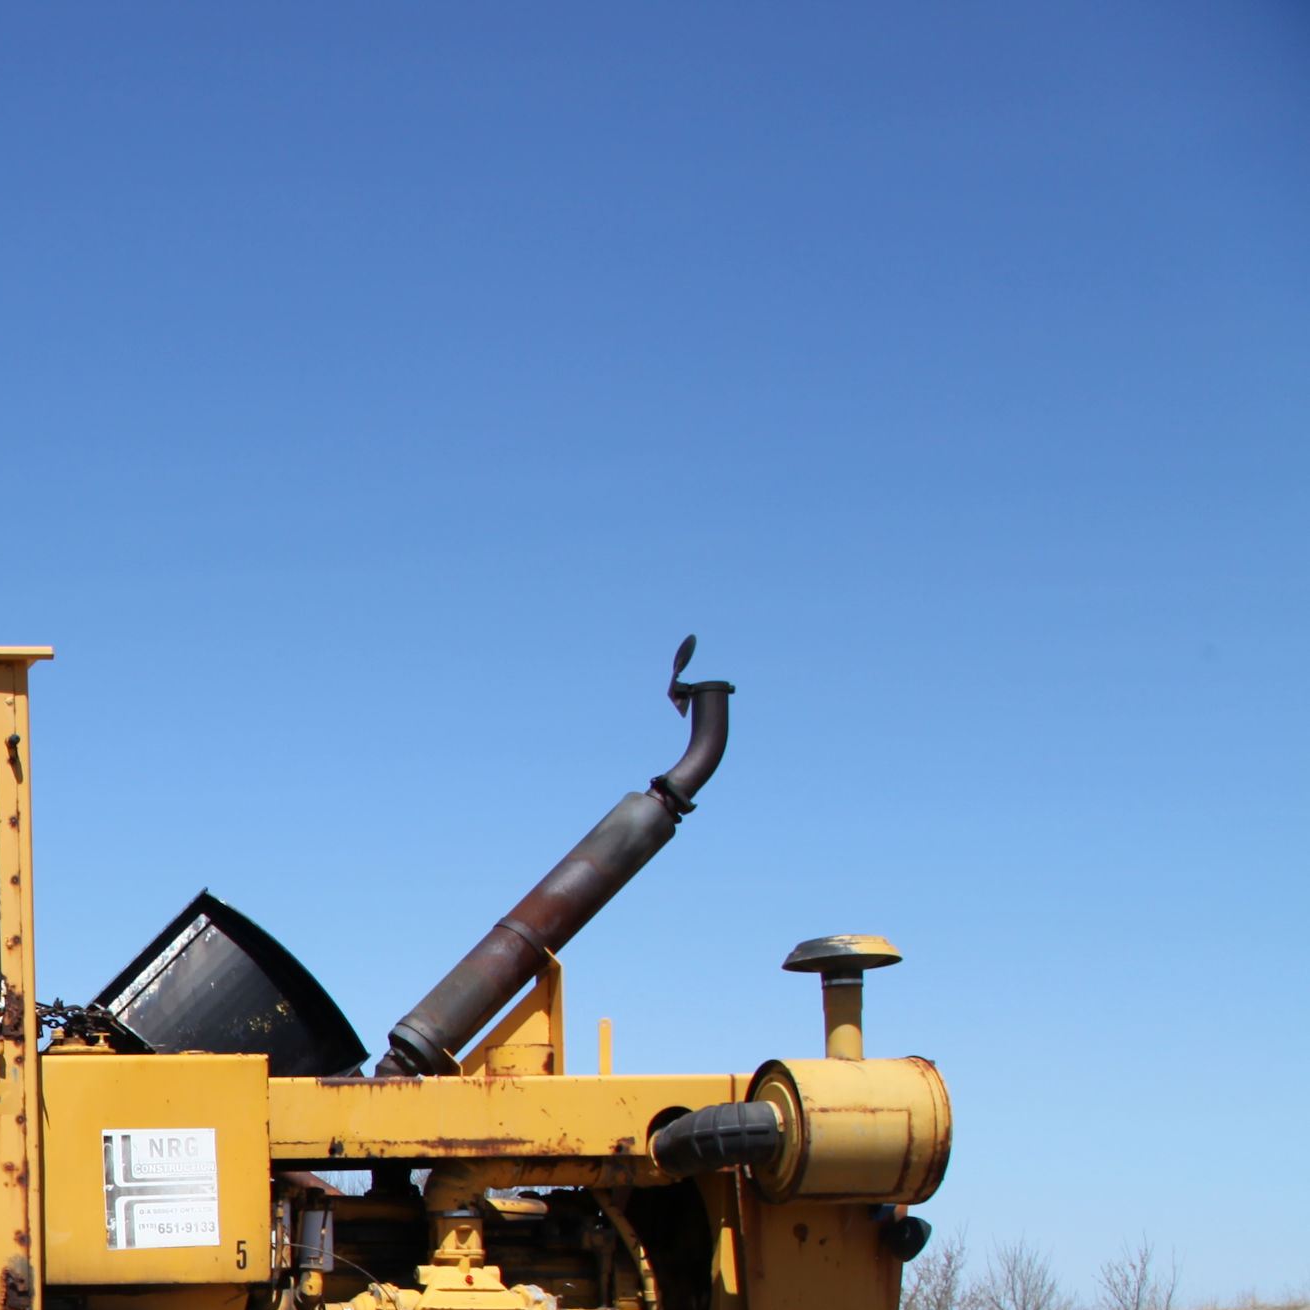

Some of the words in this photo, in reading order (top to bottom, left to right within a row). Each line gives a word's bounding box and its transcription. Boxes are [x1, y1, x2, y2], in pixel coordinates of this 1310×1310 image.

[148, 1137, 198, 1158] NRG
[133, 1161, 216, 1175] CONSTRUCTION
[236, 1240, 247, 1270] 5
